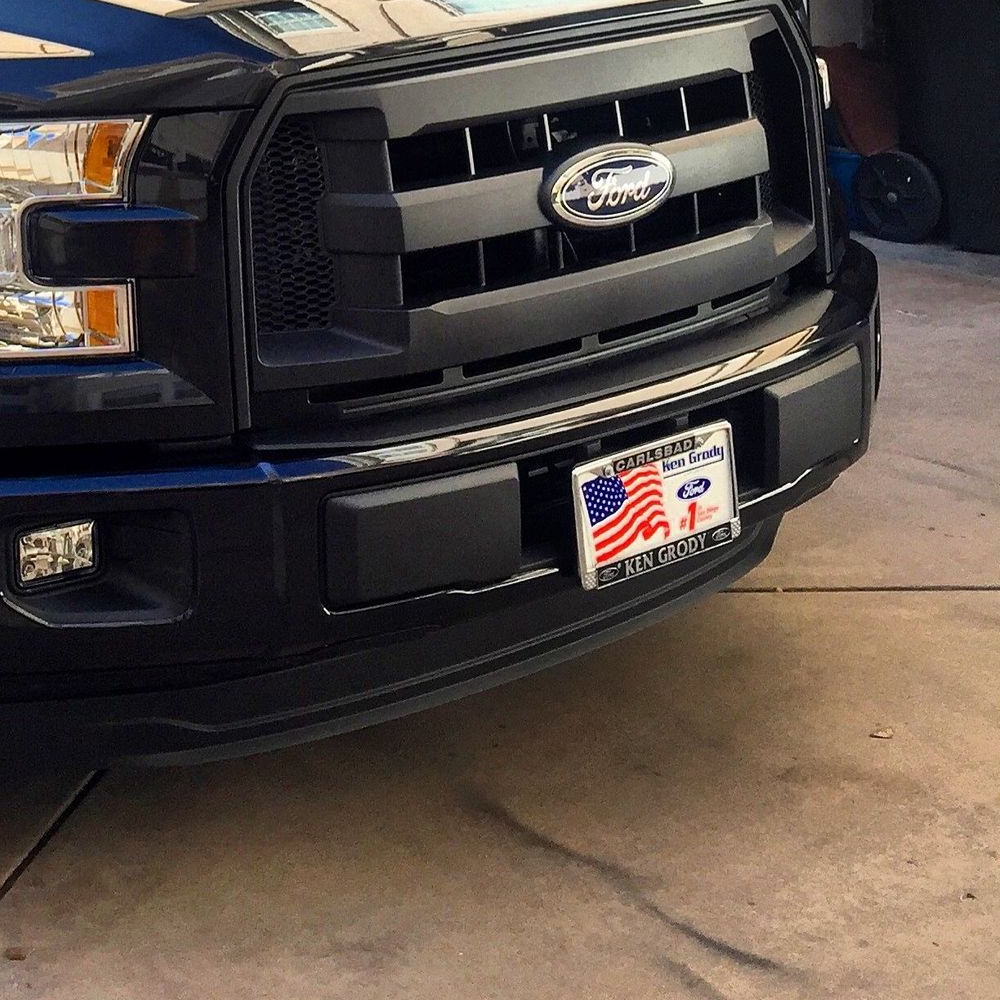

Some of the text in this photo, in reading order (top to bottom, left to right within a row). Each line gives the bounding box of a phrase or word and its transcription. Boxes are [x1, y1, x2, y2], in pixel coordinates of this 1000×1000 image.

[587, 164, 652, 212] Ford
[615, 439, 693, 472] CARLSBAD
[662, 445, 725, 473] Ken Grody
[681, 479, 707, 499] Ford
[624, 551, 655, 577] KEN
[657, 532, 707, 564] GRODY
